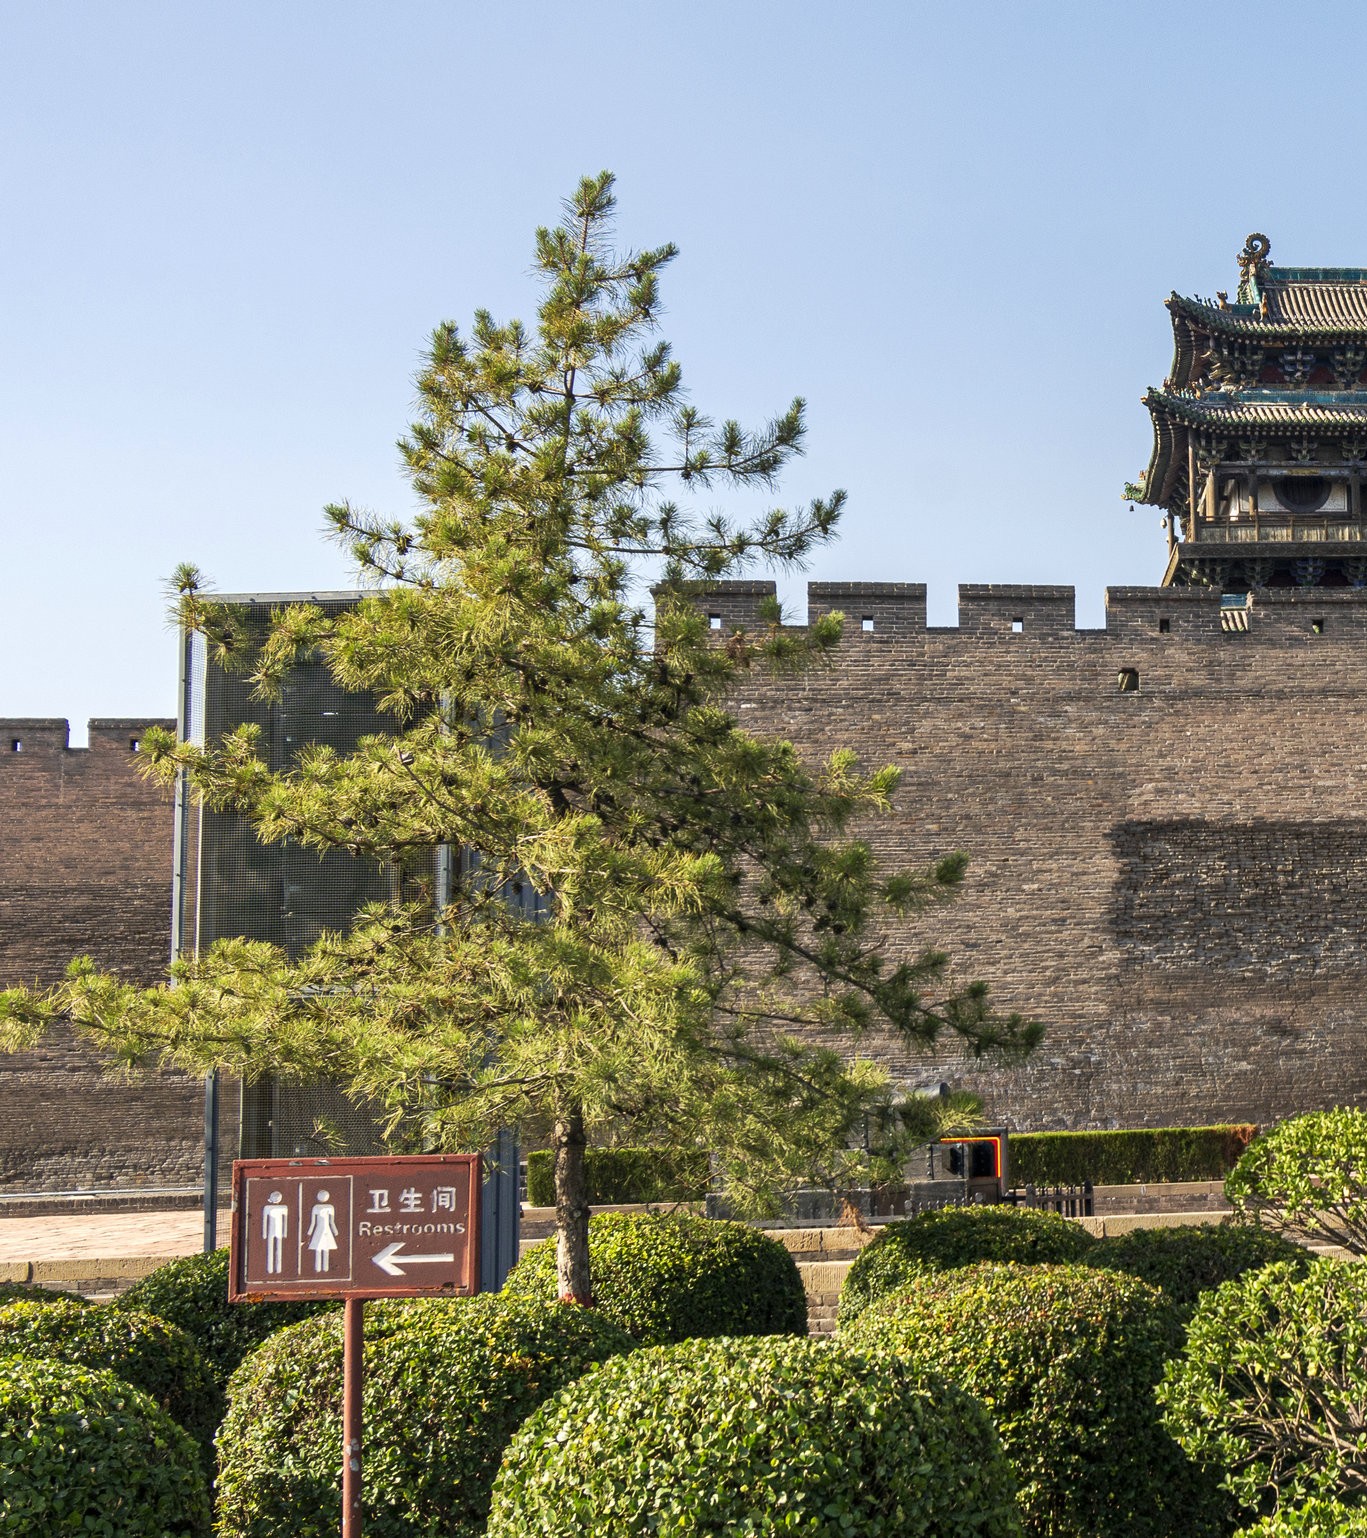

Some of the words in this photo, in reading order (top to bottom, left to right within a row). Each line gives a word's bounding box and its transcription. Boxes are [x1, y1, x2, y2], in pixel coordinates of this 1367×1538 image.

[366, 1186, 457, 1213] 卫生间
[359, 1220, 466, 1236] Restrooms
